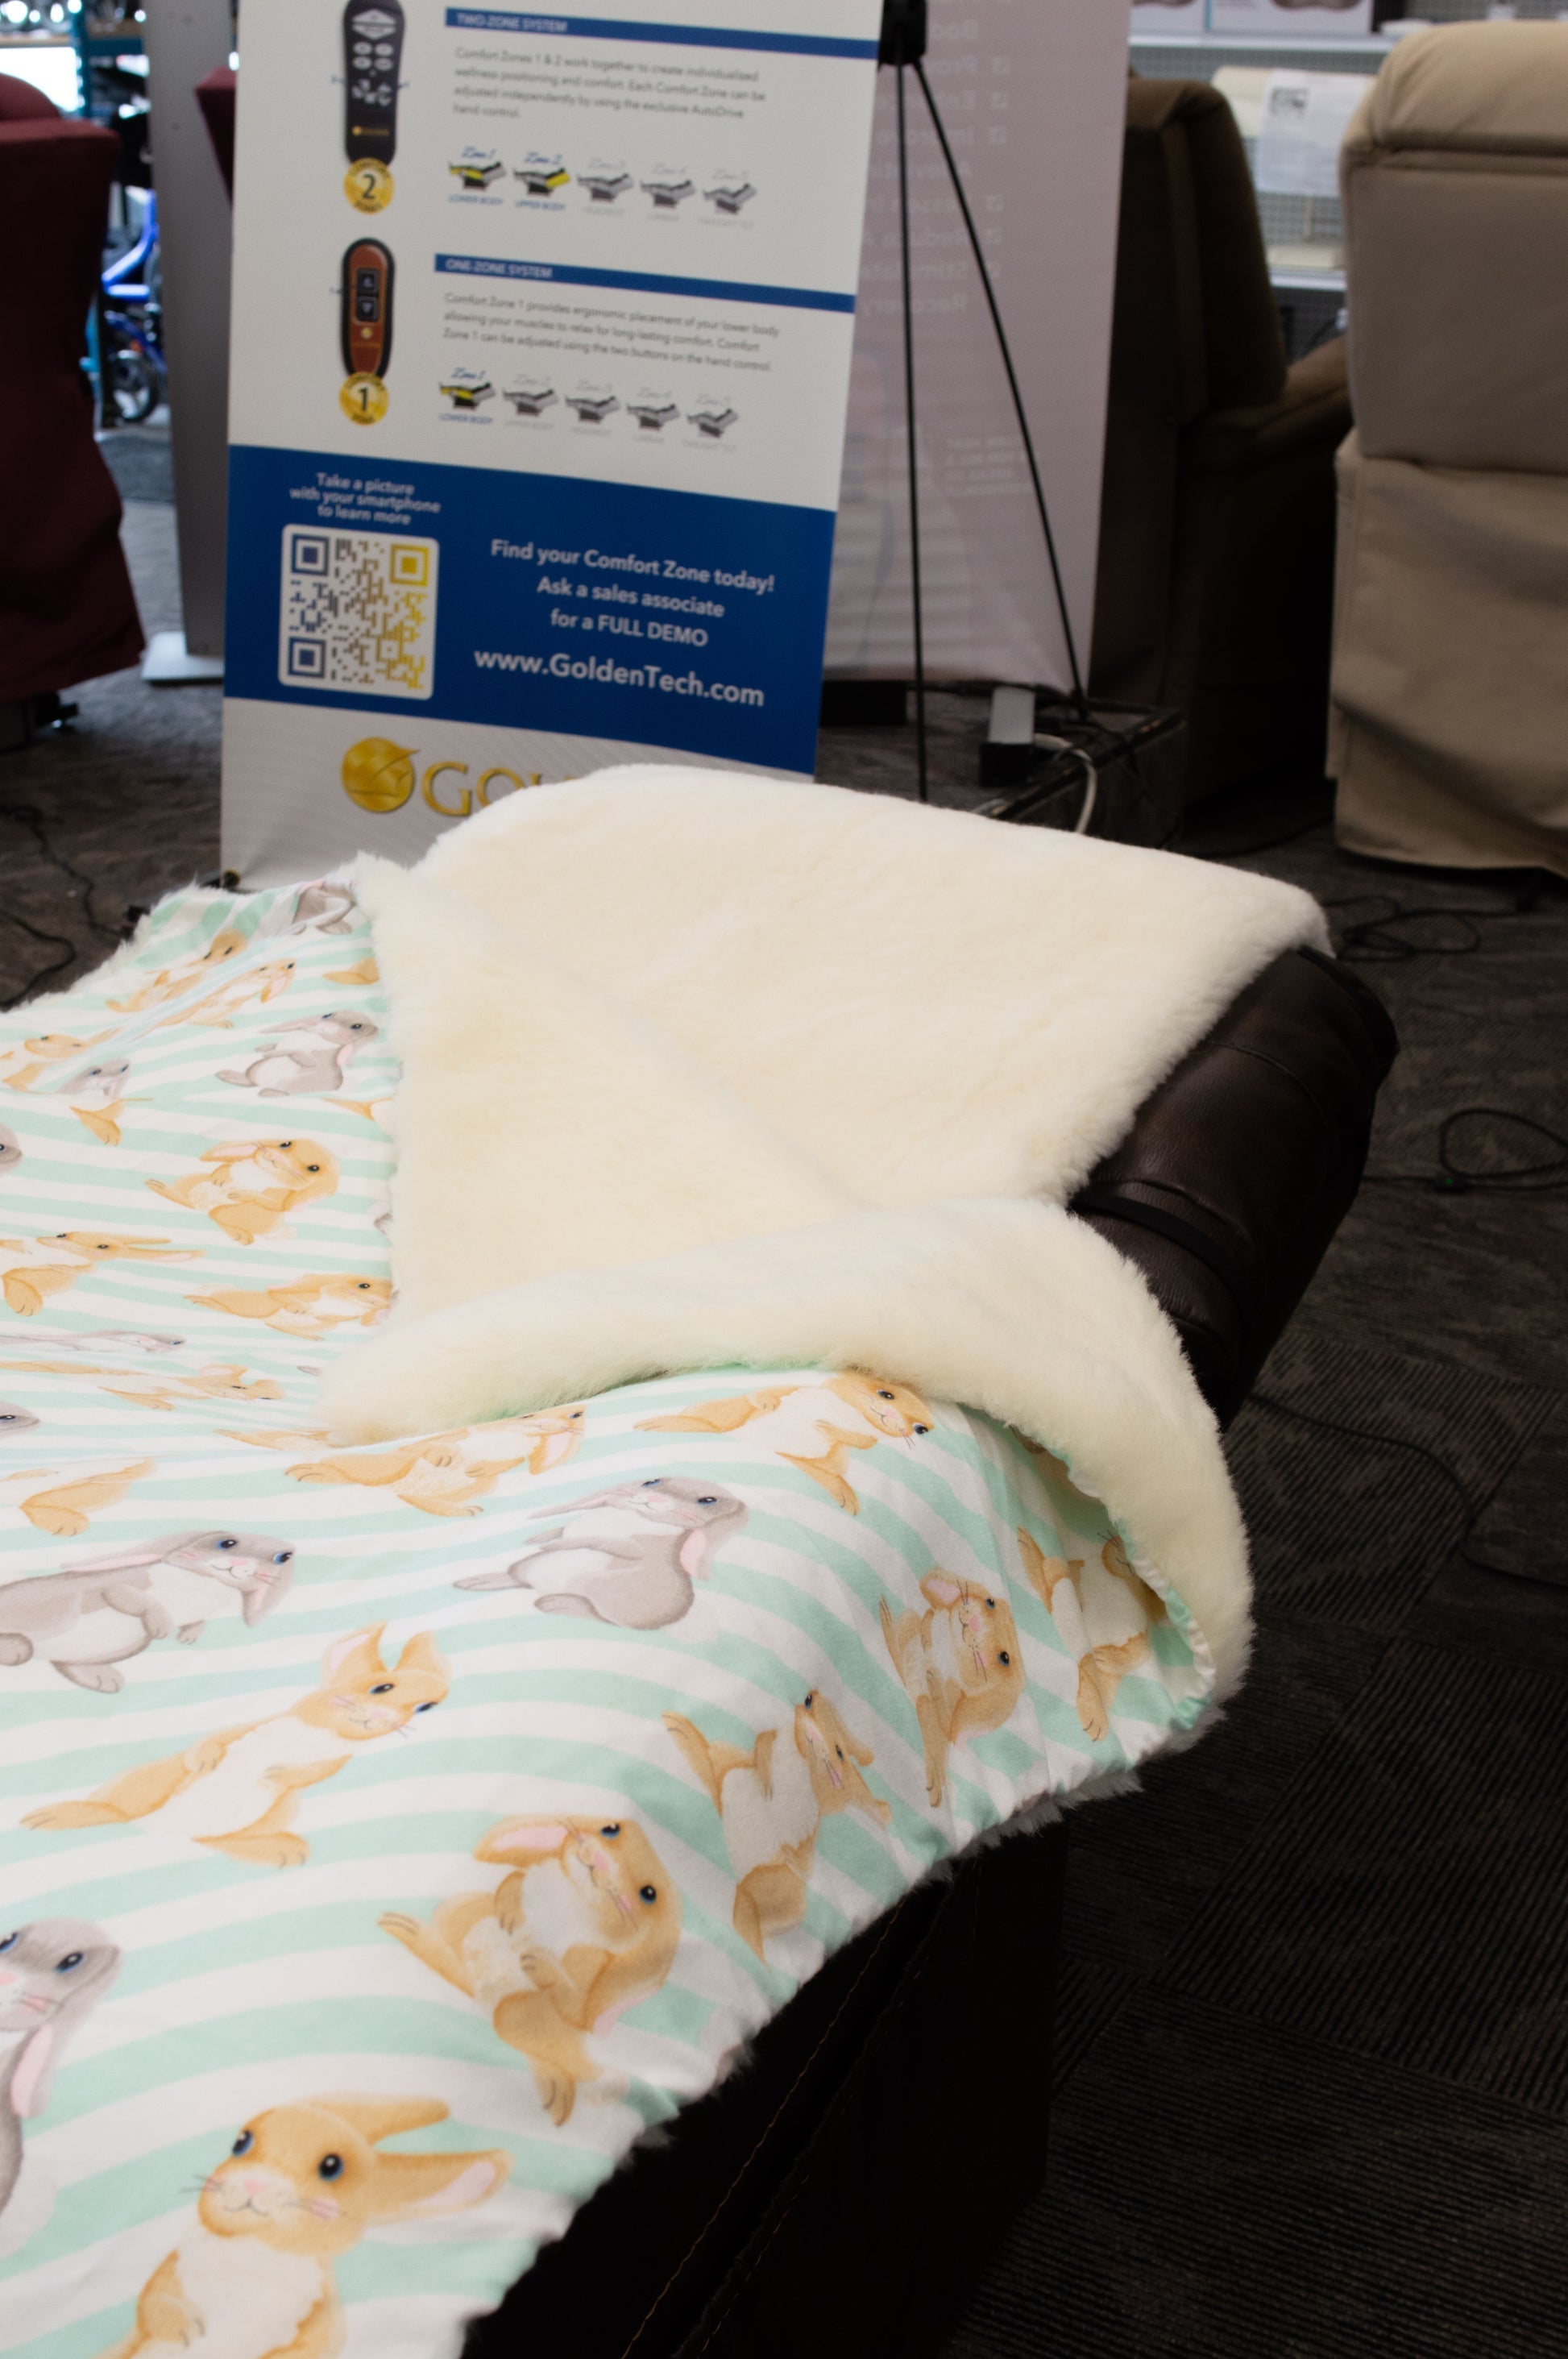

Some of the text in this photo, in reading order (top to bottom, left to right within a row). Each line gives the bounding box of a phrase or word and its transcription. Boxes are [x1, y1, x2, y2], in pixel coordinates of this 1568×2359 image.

[523, 17, 568, 32] SYSTEM
[454, 47, 499, 59] Comfort
[565, 56, 589, 67] work
[591, 60, 634, 73] together
[637, 63, 648, 73] to
[651, 65, 682, 76] create
[500, 71, 558, 87] positioning
[562, 75, 581, 86] and
[628, 80, 652, 91] Each
[656, 81, 699, 95] Comfort
[700, 85, 728, 97] Zone
[731, 89, 749, 100] can
[751, 90, 765, 102] be
[578, 94, 591, 107] by
[624, 98, 640, 110] the
[643, 101, 689, 114] exclusive
[362, 172, 376, 200] 2
[508, 263, 553, 278] SYSTEM
[444, 292, 487, 305] Comfort
[488, 295, 516, 309] Zone
[526, 301, 571, 314] provides
[573, 306, 626, 319] ergonomic
[628, 311, 683, 326] placement
[685, 317, 696, 327] of
[696, 320, 718, 331] your
[722, 322, 749, 334] lower
[752, 324, 781, 338] body
[444, 310, 487, 326] allowing
[488, 316, 512, 327] your
[515, 317, 554, 330] muscles
[557, 321, 567, 331] to
[569, 323, 594, 335] relax
[595, 324, 609, 336] for
[716, 337, 761, 351] Comfort
[443, 327, 470, 340] Zone
[480, 332, 498, 343] can
[500, 333, 515, 344] be
[516, 335, 562, 350] adjusted
[564, 340, 591, 355] using
[592, 343, 608, 355] the
[610, 346, 628, 356] two
[630, 347, 669, 360] buttons
[670, 352, 684, 363] on
[687, 353, 703, 364] the
[705, 355, 732, 368] hand
[357, 387, 368, 412] 1
[317, 472, 415, 496] Take a picture
[289, 486, 442, 513] with your smartphone
[317, 504, 412, 525] to learn more
[491, 538, 775, 596] Find your Comfort Zone today!
[537, 576, 725, 618] Ask a sales associate
[550, 608, 708, 647] for a FULL DEMO
[474, 650, 765, 708] www.GoldenTech.com
